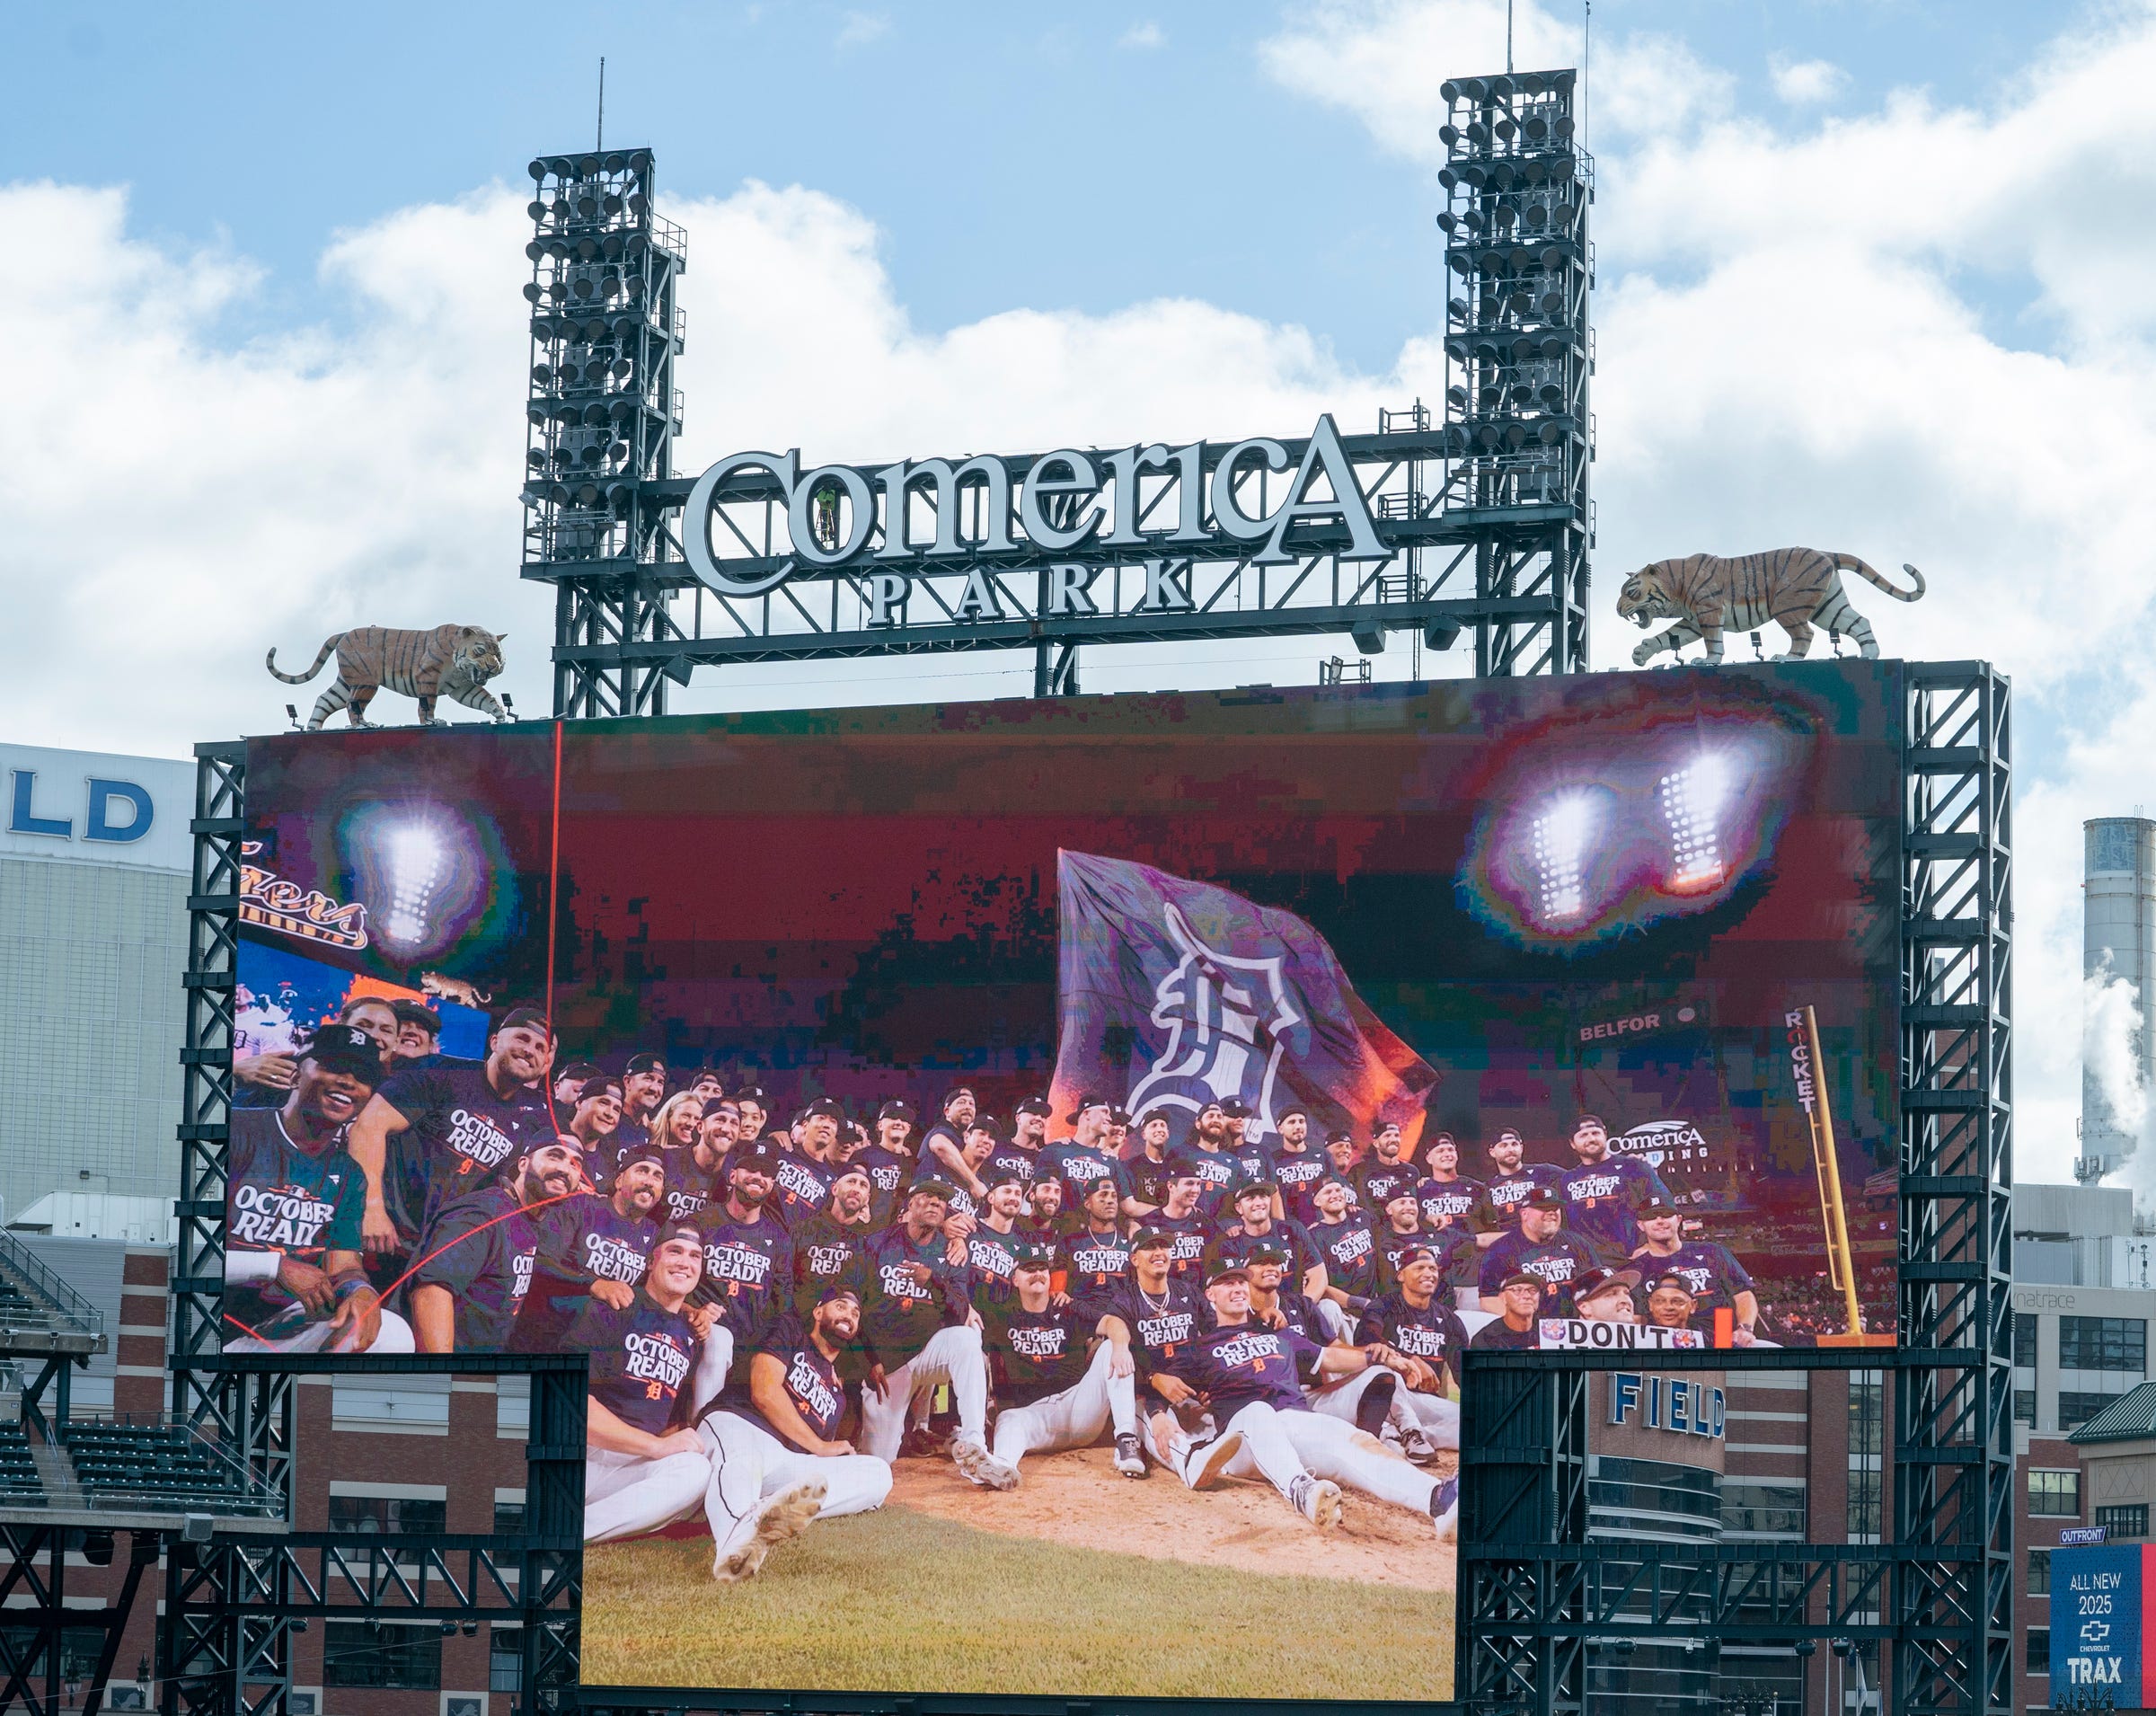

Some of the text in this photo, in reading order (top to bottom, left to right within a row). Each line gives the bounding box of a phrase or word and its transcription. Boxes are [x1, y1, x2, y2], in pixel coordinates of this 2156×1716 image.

[868, 559, 1196, 628] PARK
[6, 769, 155, 845] LD
[1580, 1014, 1660, 1041] BELFOR
[1785, 1012, 1815, 1114] ROCKET
[450, 1109, 514, 1158] OCTOBER
[446, 1127, 506, 1168] READY
[871, 1168, 901, 1179] OCTO
[1199, 1168, 1229, 1184] EADY
[1277, 1163, 1323, 1176] OCTOBER
[1282, 1171, 1320, 1183] READY
[775, 1171, 819, 1203] READY
[1568, 1176, 1620, 1191] OCTOBER
[1571, 1185, 1614, 1200] READY
[235, 1185, 336, 1224] OCTOBER
[667, 1191, 707, 1212] OCTO
[1422, 1197, 1472, 1208] OCTOBER
[1427, 1205, 1468, 1216] READY
[1170, 1245, 1201, 1259] EADY
[1175, 1236, 1205, 1247] OBER
[1330, 1228, 1372, 1256] OCTOBER
[1338, 1239, 1373, 1264] READY
[703, 1243, 771, 1272] OCTOBER
[971, 1252, 1013, 1278] READY
[1074, 1250, 1129, 1263] OCTOBER
[1079, 1260, 1126, 1273] READY
[585, 1256, 642, 1287] READY
[706, 1259, 764, 1284] READY
[2014, 1289, 2075, 1309] natrace
[1007, 1326, 1065, 1342] OCTOBER
[1137, 1313, 1194, 1332] OCTOBER
[1143, 1327, 1190, 1347] READY
[1212, 1334, 1280, 1358] OCTOBER
[1568, 1321, 1668, 1349] DON'T
[624, 1332, 690, 1377] OCTOBER
[1012, 1340, 1061, 1356] READY
[1223, 1343, 1279, 1367] READY
[625, 1352, 685, 1390] READY
[788, 1366, 833, 1420] READY
[1608, 1371, 1726, 1439] FIELD
[2062, 1528, 2104, 1543] OUTFRONT
[2070, 1572, 2121, 1590] ALL NEW
[2079, 1595, 2111, 1615] 2025
[2067, 1657, 2122, 1685] TRAX
